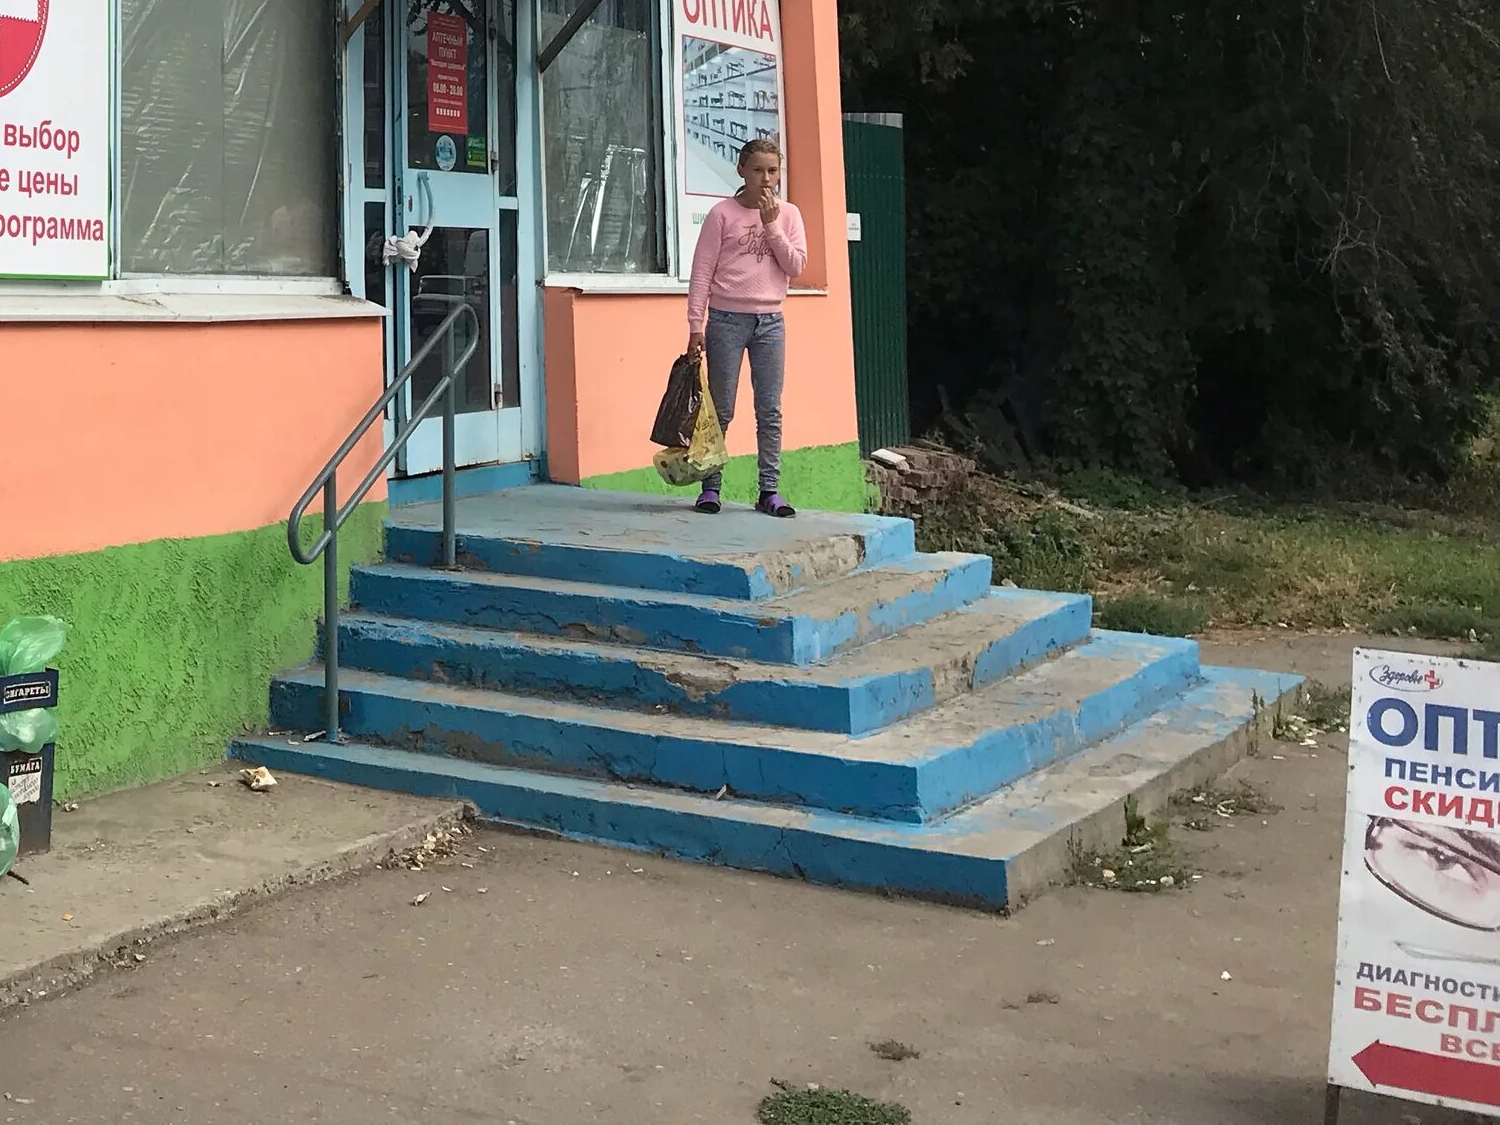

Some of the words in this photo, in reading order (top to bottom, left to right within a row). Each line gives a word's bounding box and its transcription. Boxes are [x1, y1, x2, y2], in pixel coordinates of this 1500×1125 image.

[4, 120, 80, 159] выбор
[18, 169, 78, 198] цены
[1366, 697, 1500, 759] ОПТ
[10, 761, 40, 774] БУМАГА
[1384, 757, 1500, 793] ПЕНСИ
[1384, 785, 1500, 828] СКИД
